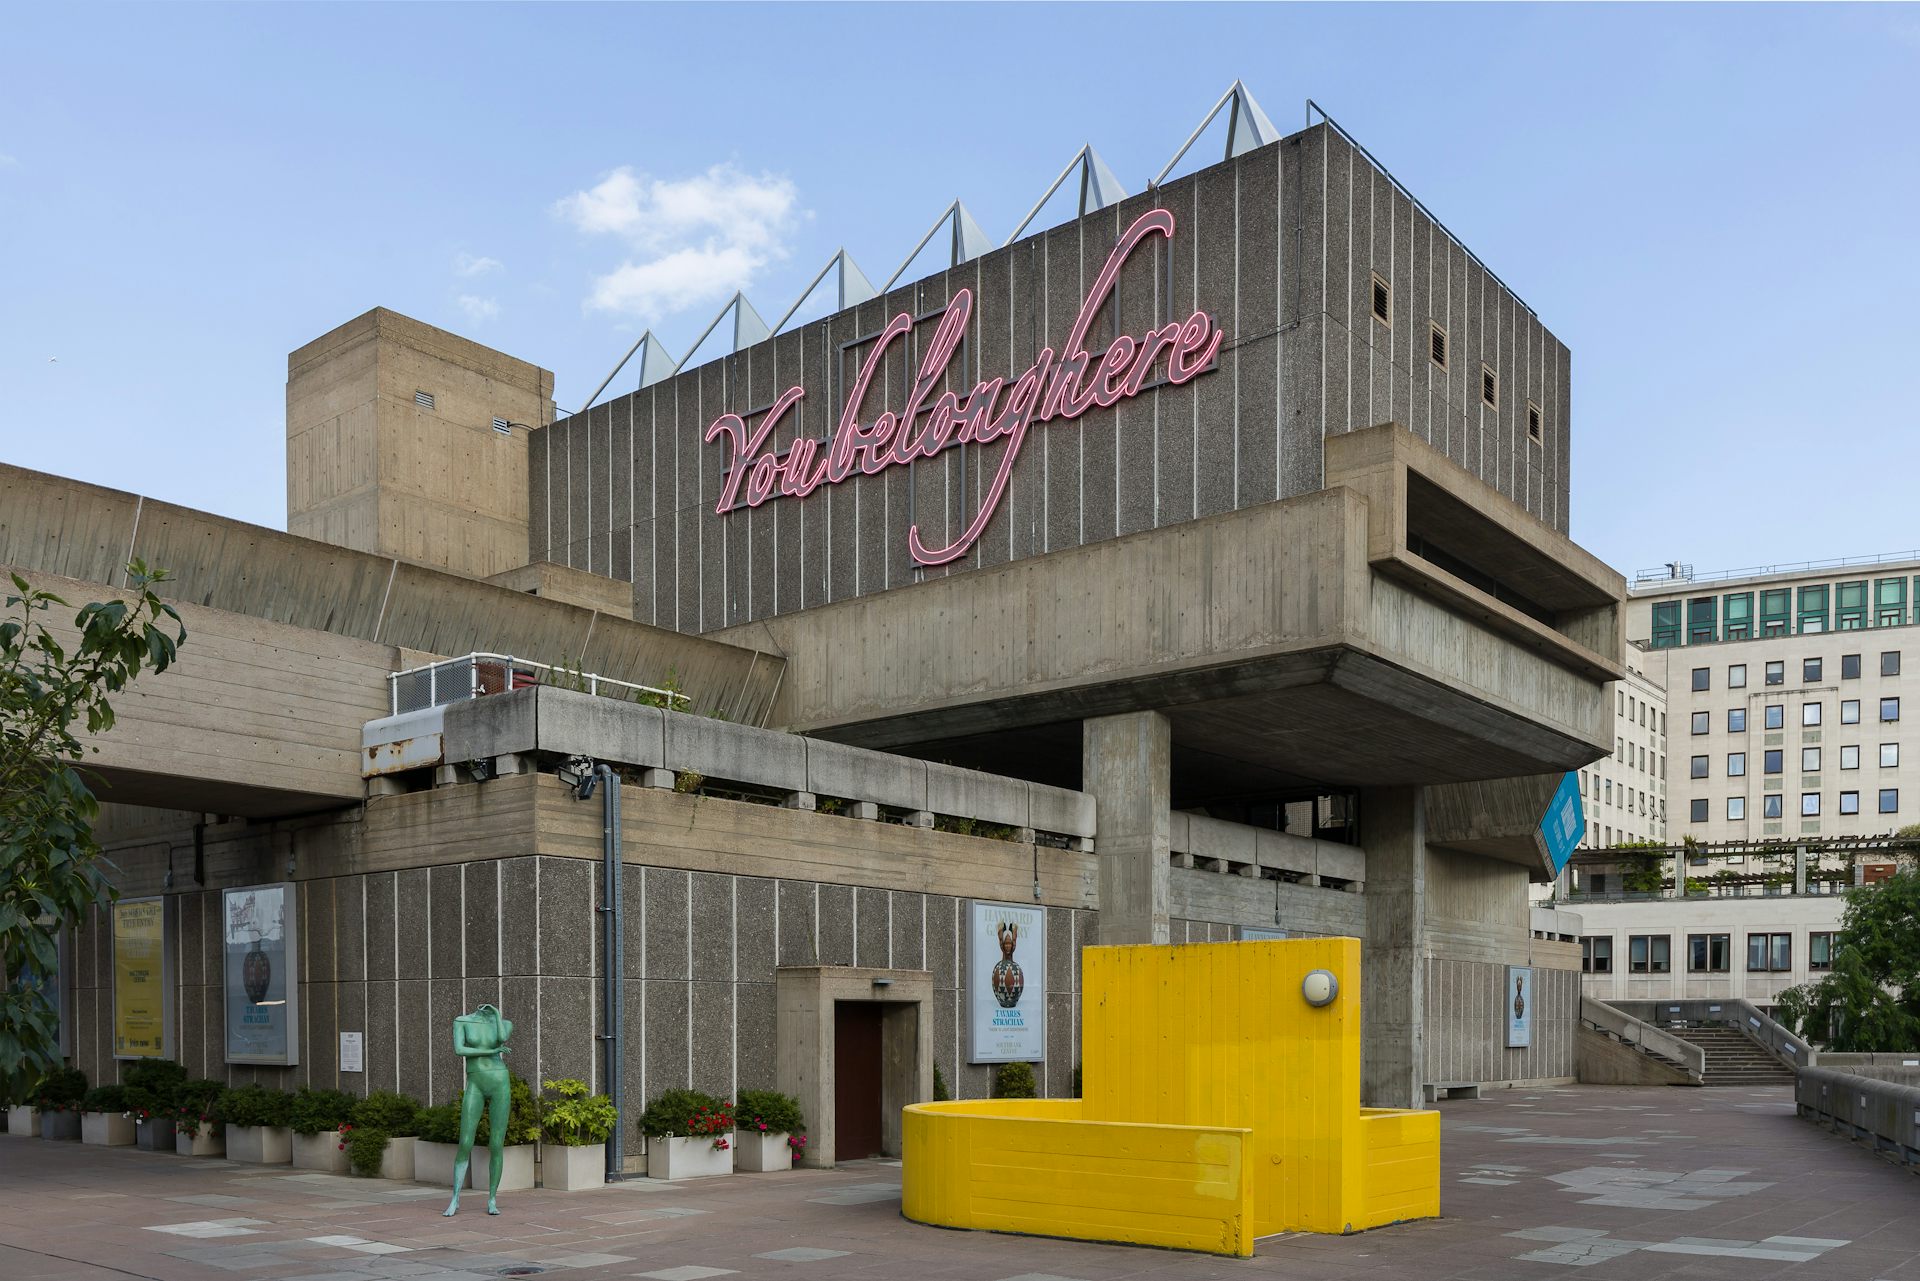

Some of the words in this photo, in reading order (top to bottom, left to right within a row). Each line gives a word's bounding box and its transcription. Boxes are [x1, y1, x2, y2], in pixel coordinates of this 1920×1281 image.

[705, 386, 828, 514] You
[826, 288, 1053, 565] belong
[1041, 208, 1223, 420] here
[984, 909, 1033, 924] HAYWARD
[995, 1010, 1021, 1018] TAVARES
[992, 1018, 1024, 1026] STRACHAN
